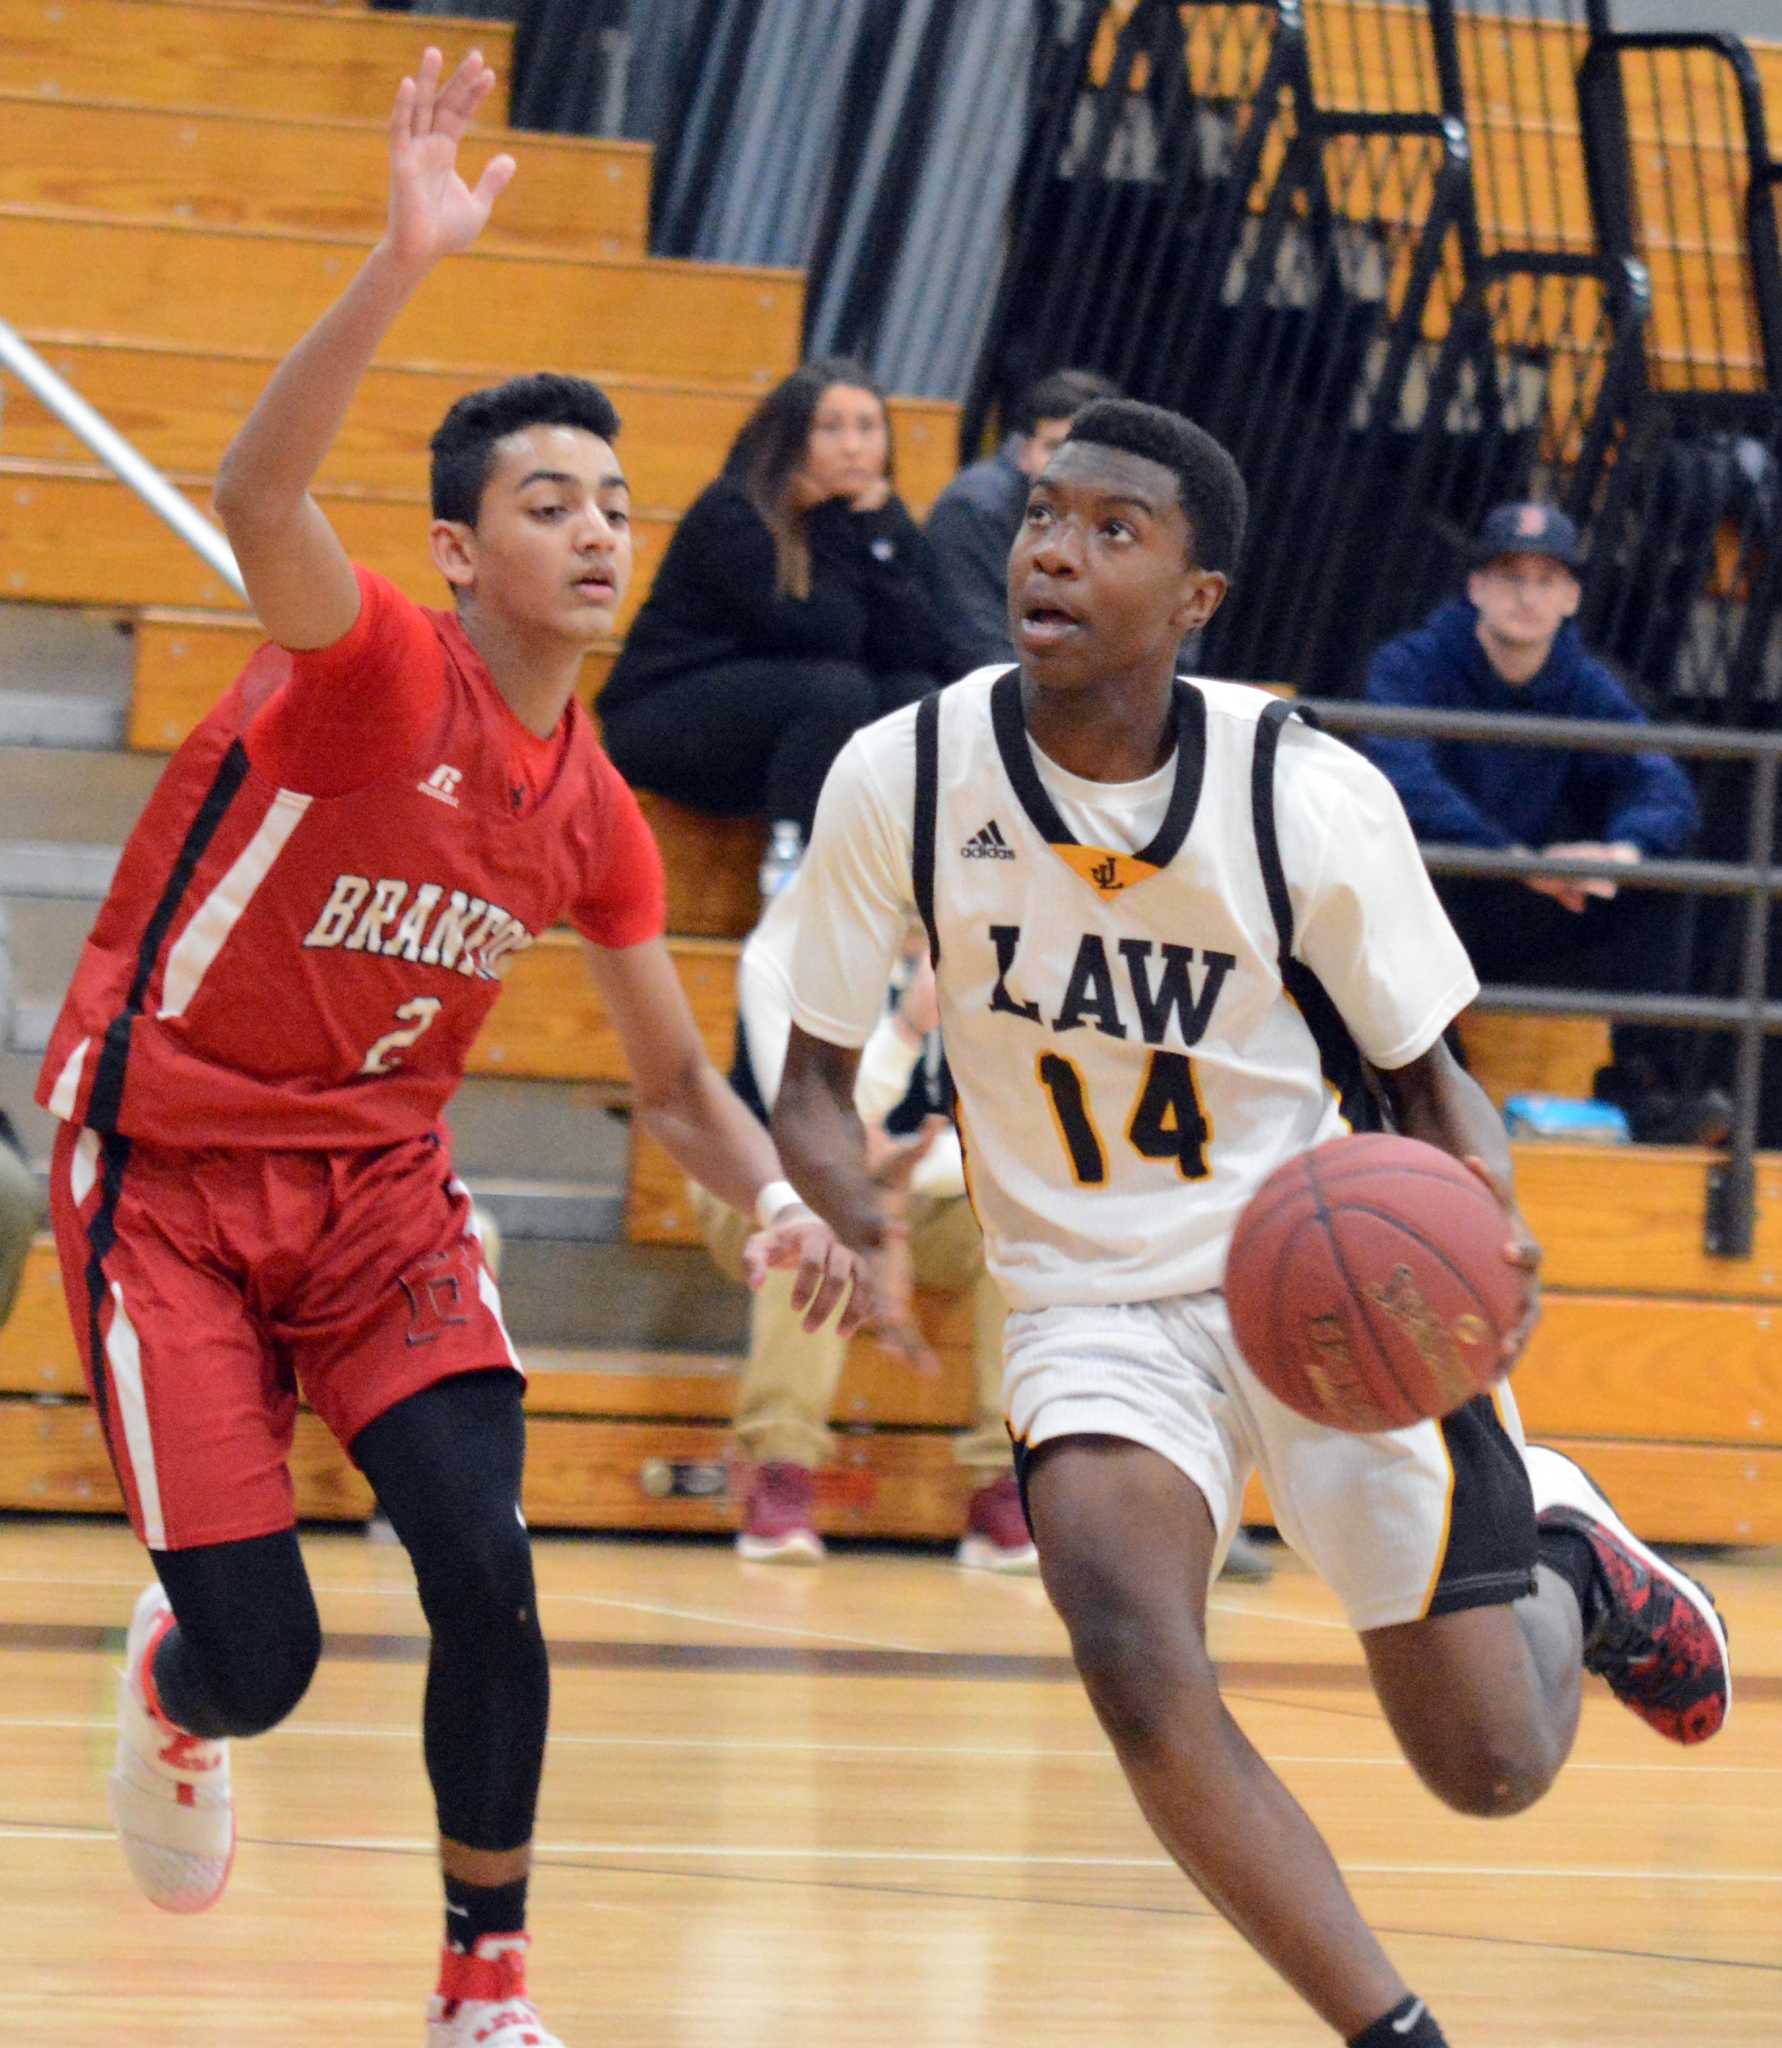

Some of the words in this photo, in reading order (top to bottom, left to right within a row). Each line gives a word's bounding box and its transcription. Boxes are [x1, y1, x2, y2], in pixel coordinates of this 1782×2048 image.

[960, 844, 1016, 860] adidas
[360, 996, 443, 1075] 2
[989, 925, 1236, 1047] LAW
[1035, 1046, 1214, 1190] 14
